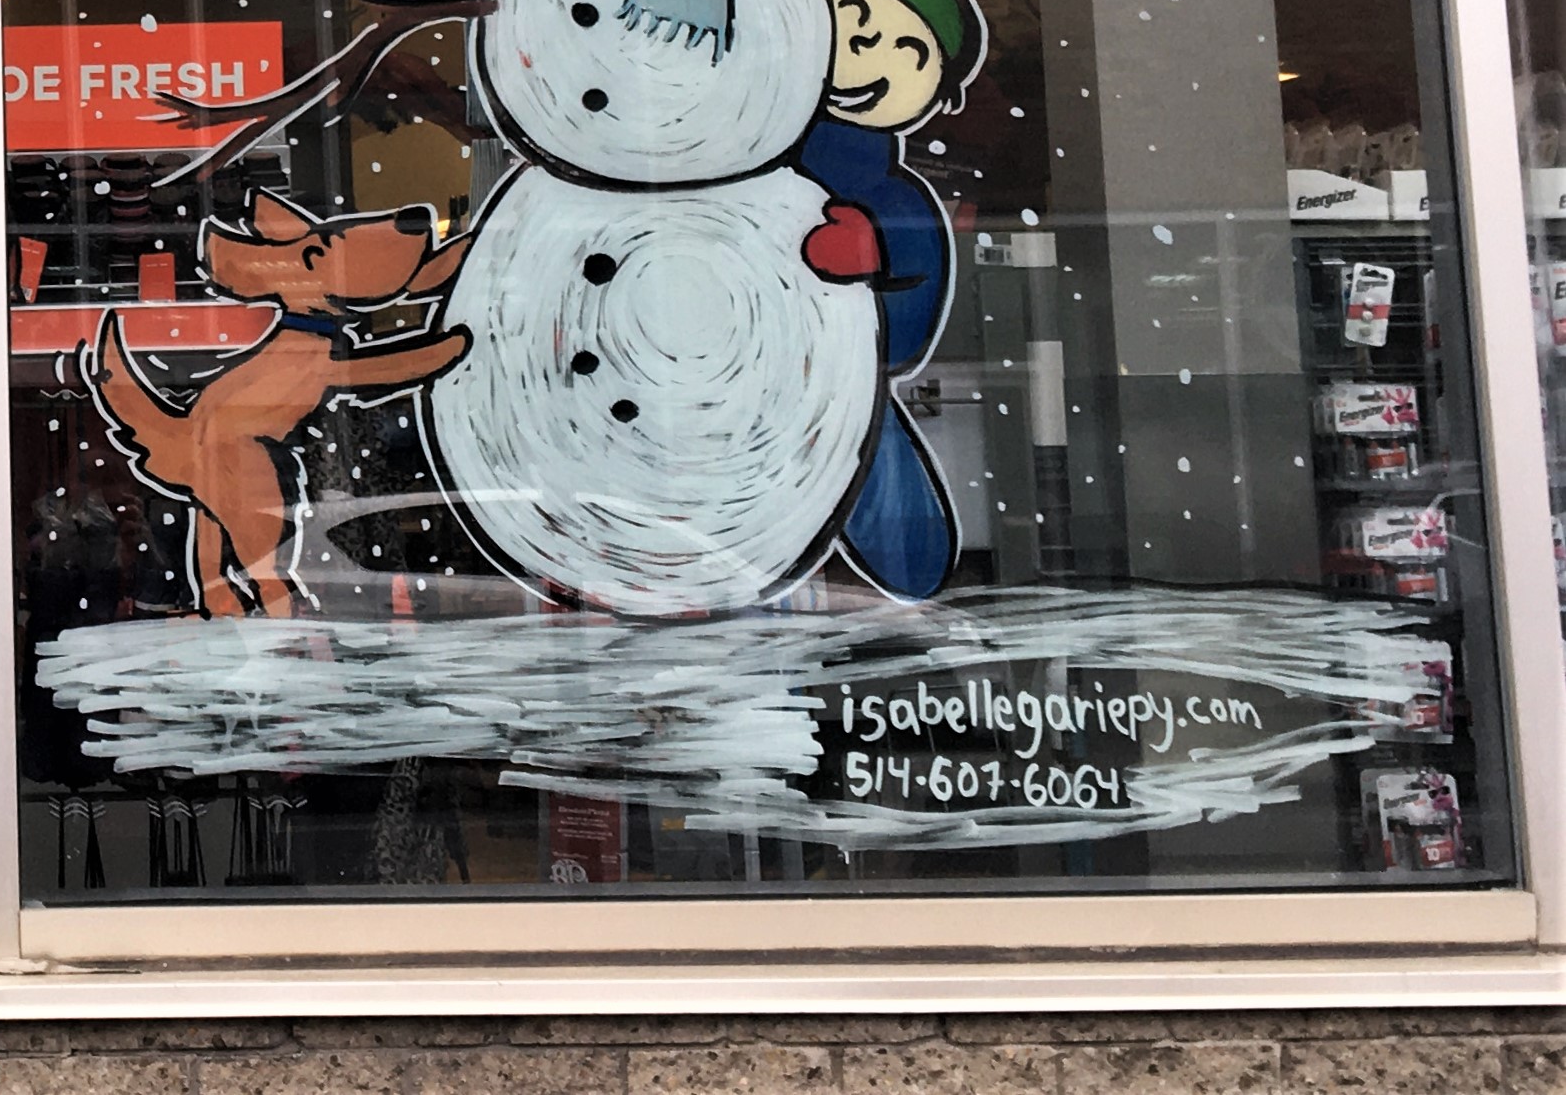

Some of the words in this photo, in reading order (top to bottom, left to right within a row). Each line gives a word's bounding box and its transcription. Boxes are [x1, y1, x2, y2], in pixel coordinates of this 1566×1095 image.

[80, 61, 245, 100] FRESH
[1296, 188, 1358, 211] Energizer
[841, 678, 1263, 759] isabellegariepy.com
